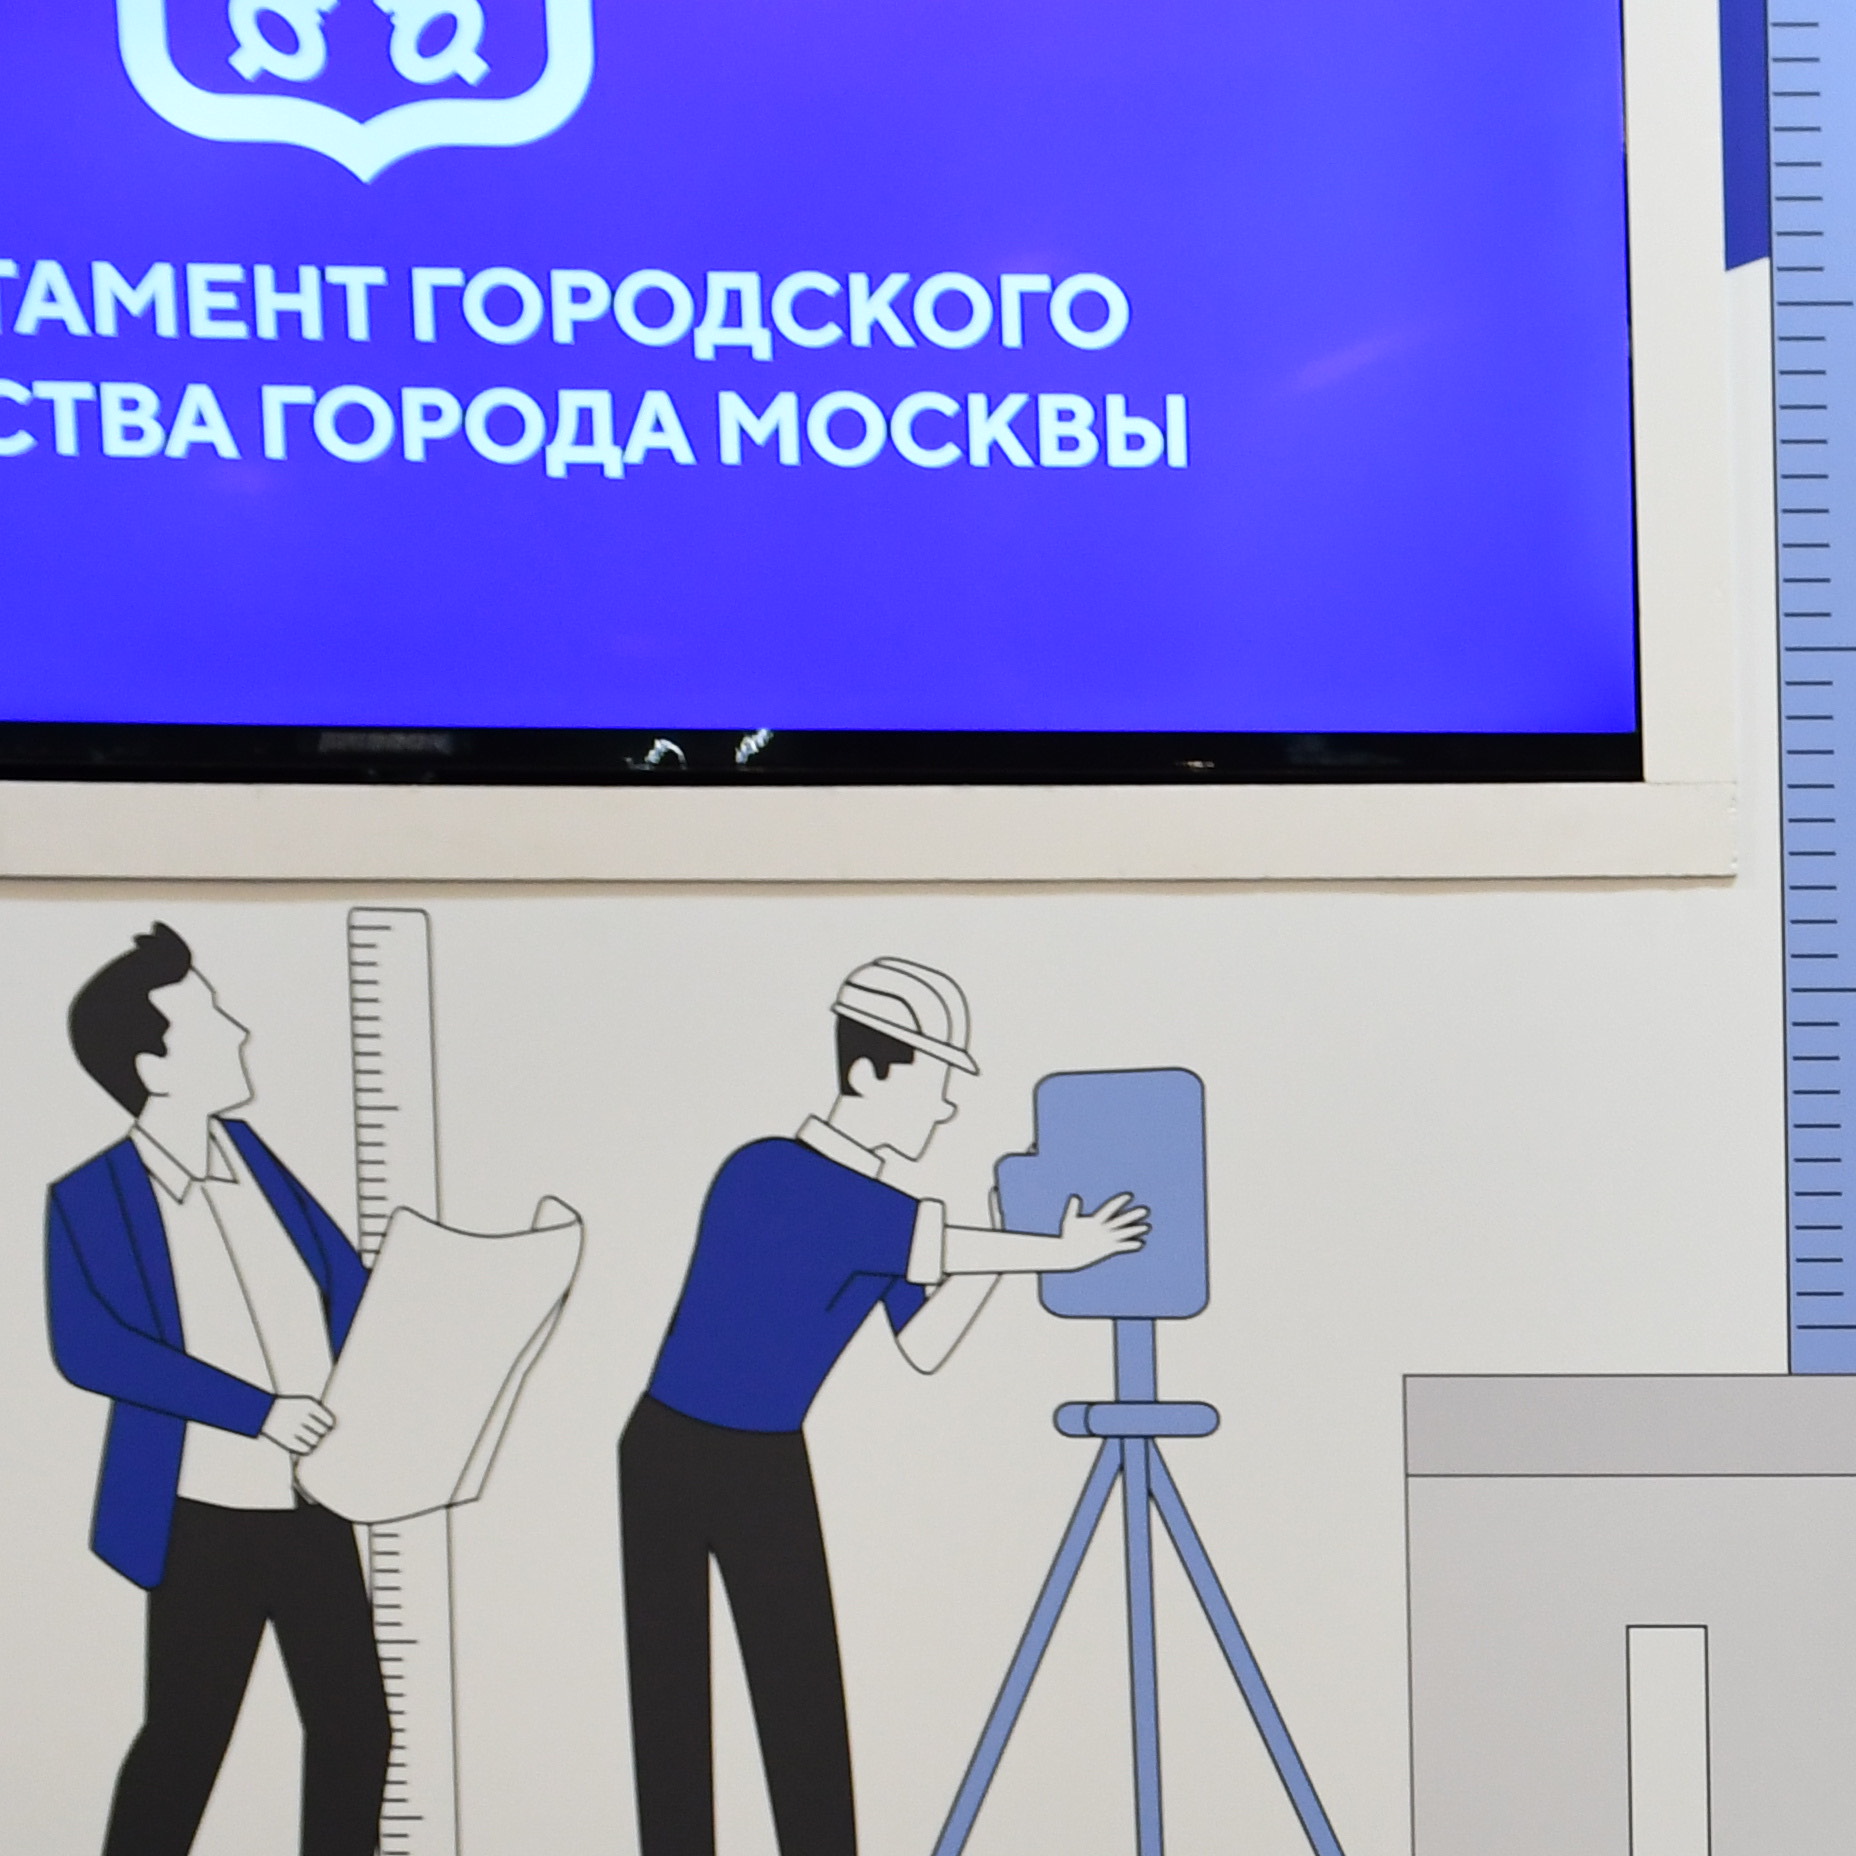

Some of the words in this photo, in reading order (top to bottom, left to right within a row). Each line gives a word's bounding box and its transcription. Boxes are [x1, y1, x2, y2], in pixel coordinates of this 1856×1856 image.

[411, 266, 1131, 361] ГОРОДСКОГО
[261, 384, 697, 479] ГОРОДА
[718, 389, 1189, 469] МОСКВЫ
